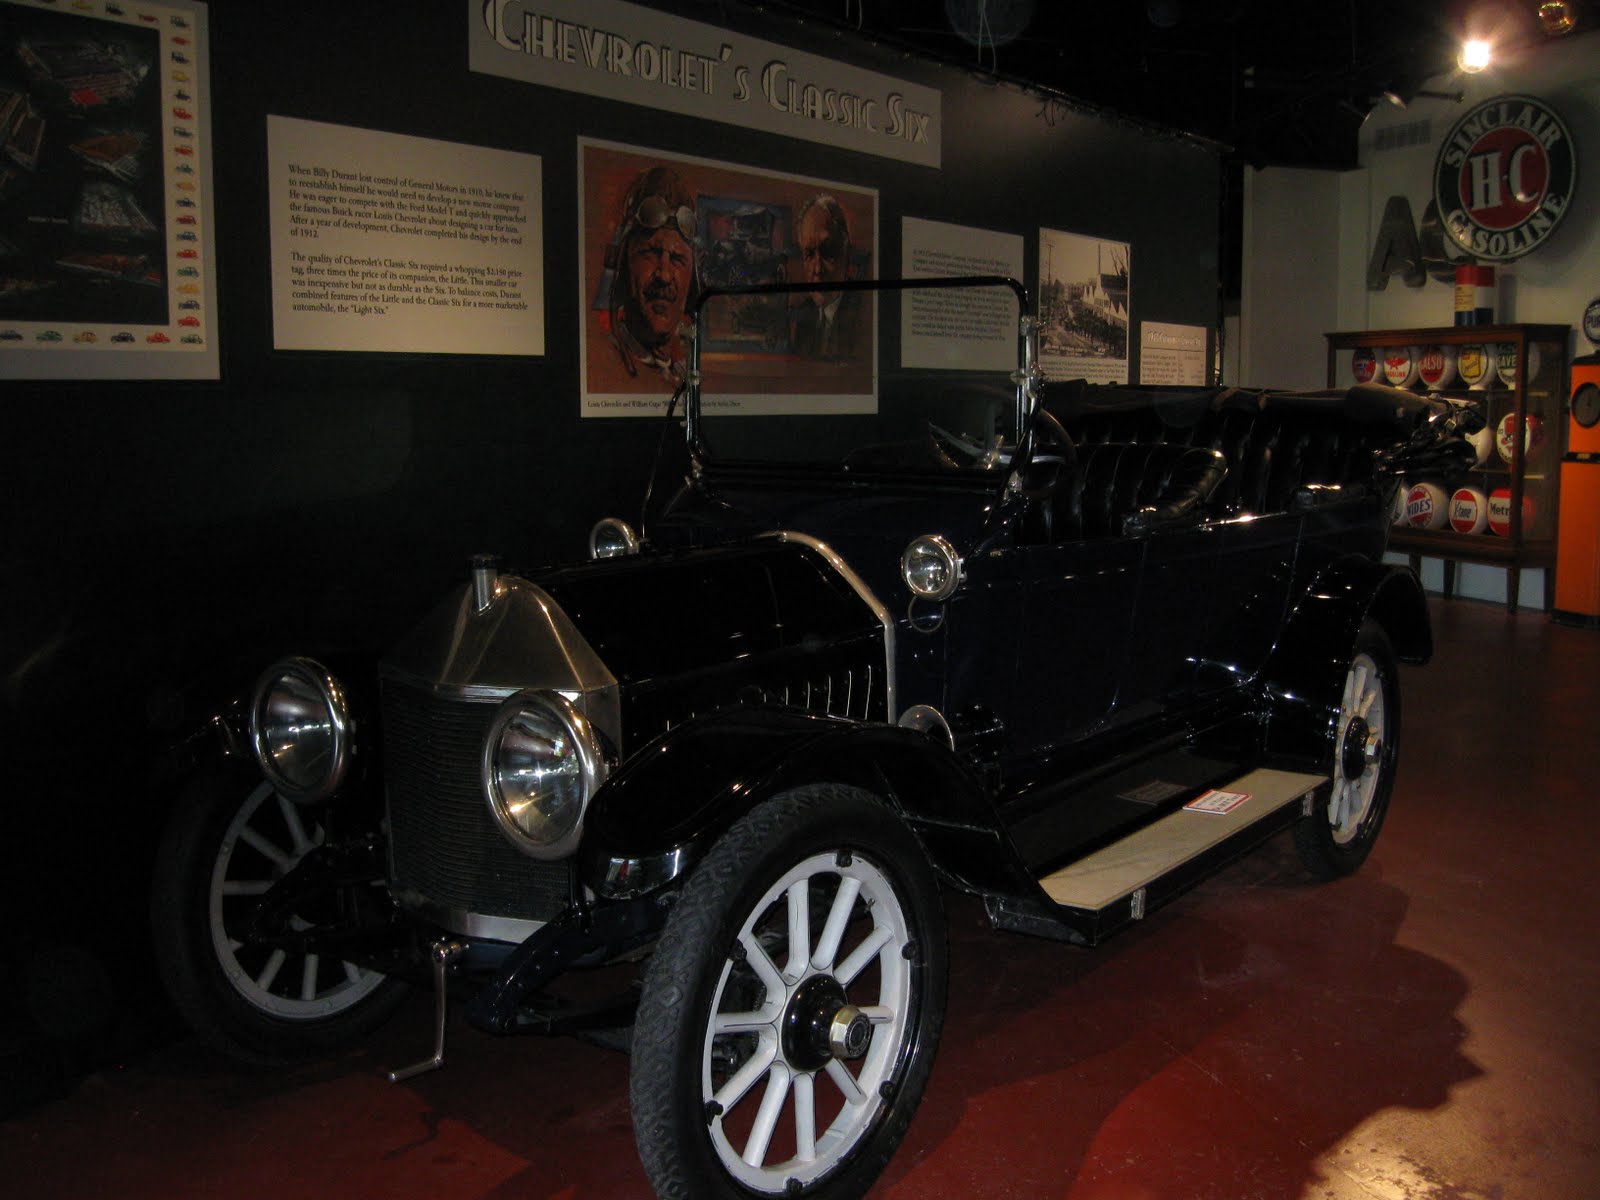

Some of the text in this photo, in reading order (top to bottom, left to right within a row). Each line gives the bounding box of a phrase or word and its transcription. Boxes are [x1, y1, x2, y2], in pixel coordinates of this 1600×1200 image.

[761, 59, 878, 131] CLASSIC
[885, 93, 931, 145] SIX
[1445, 103, 1562, 168] SINCLAIR
[288, 164, 311, 174] When
[314, 168, 328, 178] Billy
[332, 170, 357, 180] Durant
[360, 172, 372, 182] lost
[374, 177, 398, 186] control
[400, 178, 408, 186] of
[408, 180, 434, 190] General
[436, 182, 458, 192] Motors
[460, 186, 466, 194] in
[494, 190, 510, 199] knew
[299, 180, 338, 191] reestablish
[340, 184, 365, 194] himself
[366, 186, 376, 195] he
[378, 188, 398, 198] would
[400, 191, 416, 200] need
[426, 193, 452, 206] develop
[289, 190, 300, 198] He
[318, 196, 337, 204] eager
[349, 199, 378, 208] compete
[380, 200, 394, 208] with
[397, 202, 407, 210] the
[410, 203, 425, 212] Ford
[427, 204, 446, 214] Model
[456, 209, 467, 217] and
[469, 210, 491, 220] quickly
[493, 214, 526, 224] approached
[290, 202, 301, 211] the
[304, 204, 330, 214] famous
[332, 206, 352, 216] Buick
[355, 210, 372, 218] racer
[374, 211, 392, 220] Louis
[394, 213, 426, 224] Chevrolet
[428, 218, 446, 226] about
[448, 219, 478, 231] designing
[496, 224, 504, 232] for
[290, 216, 308, 224] After
[316, 220, 331, 228] year
[390, 225, 422, 234] Chevrolet
[424, 230, 458, 239] completed
[459, 232, 468, 240] his
[470, 232, 489, 243] design
[490, 234, 498, 244] by
[290, 228, 319, 238] of 1912.
[1447, 192, 1564, 256] GASOLINE
[292, 252, 306, 262] The
[308, 253, 332, 264] quality
[334, 255, 343, 263] of
[344, 256, 382, 266] Chevrolet's
[384, 259, 406, 268] Classic
[408, 260, 418, 269] Six
[420, 264, 448, 273] required
[454, 264, 486, 276] whopping
[508, 270, 522, 278] price
[292, 266, 304, 276] tag,
[306, 266, 325, 276] three
[327, 268, 346, 276] times
[348, 268, 360, 277] the
[362, 271, 378, 280] price
[380, 270, 388, 279] of
[399, 274, 438, 284] companion,
[439, 275, 448, 283] the
[451, 276, 469, 284] Little.
[471, 276, 484, 286] This
[486, 278, 506, 286] smaller
[292, 290, 328, 300] combined
[330, 291, 358, 300] features
[360, 293, 368, 301] of
[369, 294, 380, 302] the
[382, 294, 399, 303] Little
[402, 296, 414, 304] and
[416, 296, 426, 304] the
[428, 297, 449, 306] Classic
[462, 298, 472, 307] for
[496, 302, 528, 310] marketable
[308, 278, 349, 290] inexpensive
[352, 280, 363, 289] but
[388, 283, 412, 292] durable
[423, 285, 433, 294] the
[448, 287, 456, 295] To
[458, 288, 480, 296] balance
[500, 290, 521, 299] Durant
[292, 303, 336, 312] automobile,
[338, 304, 349, 312] the
[1489, 502, 1512, 516] Metr
